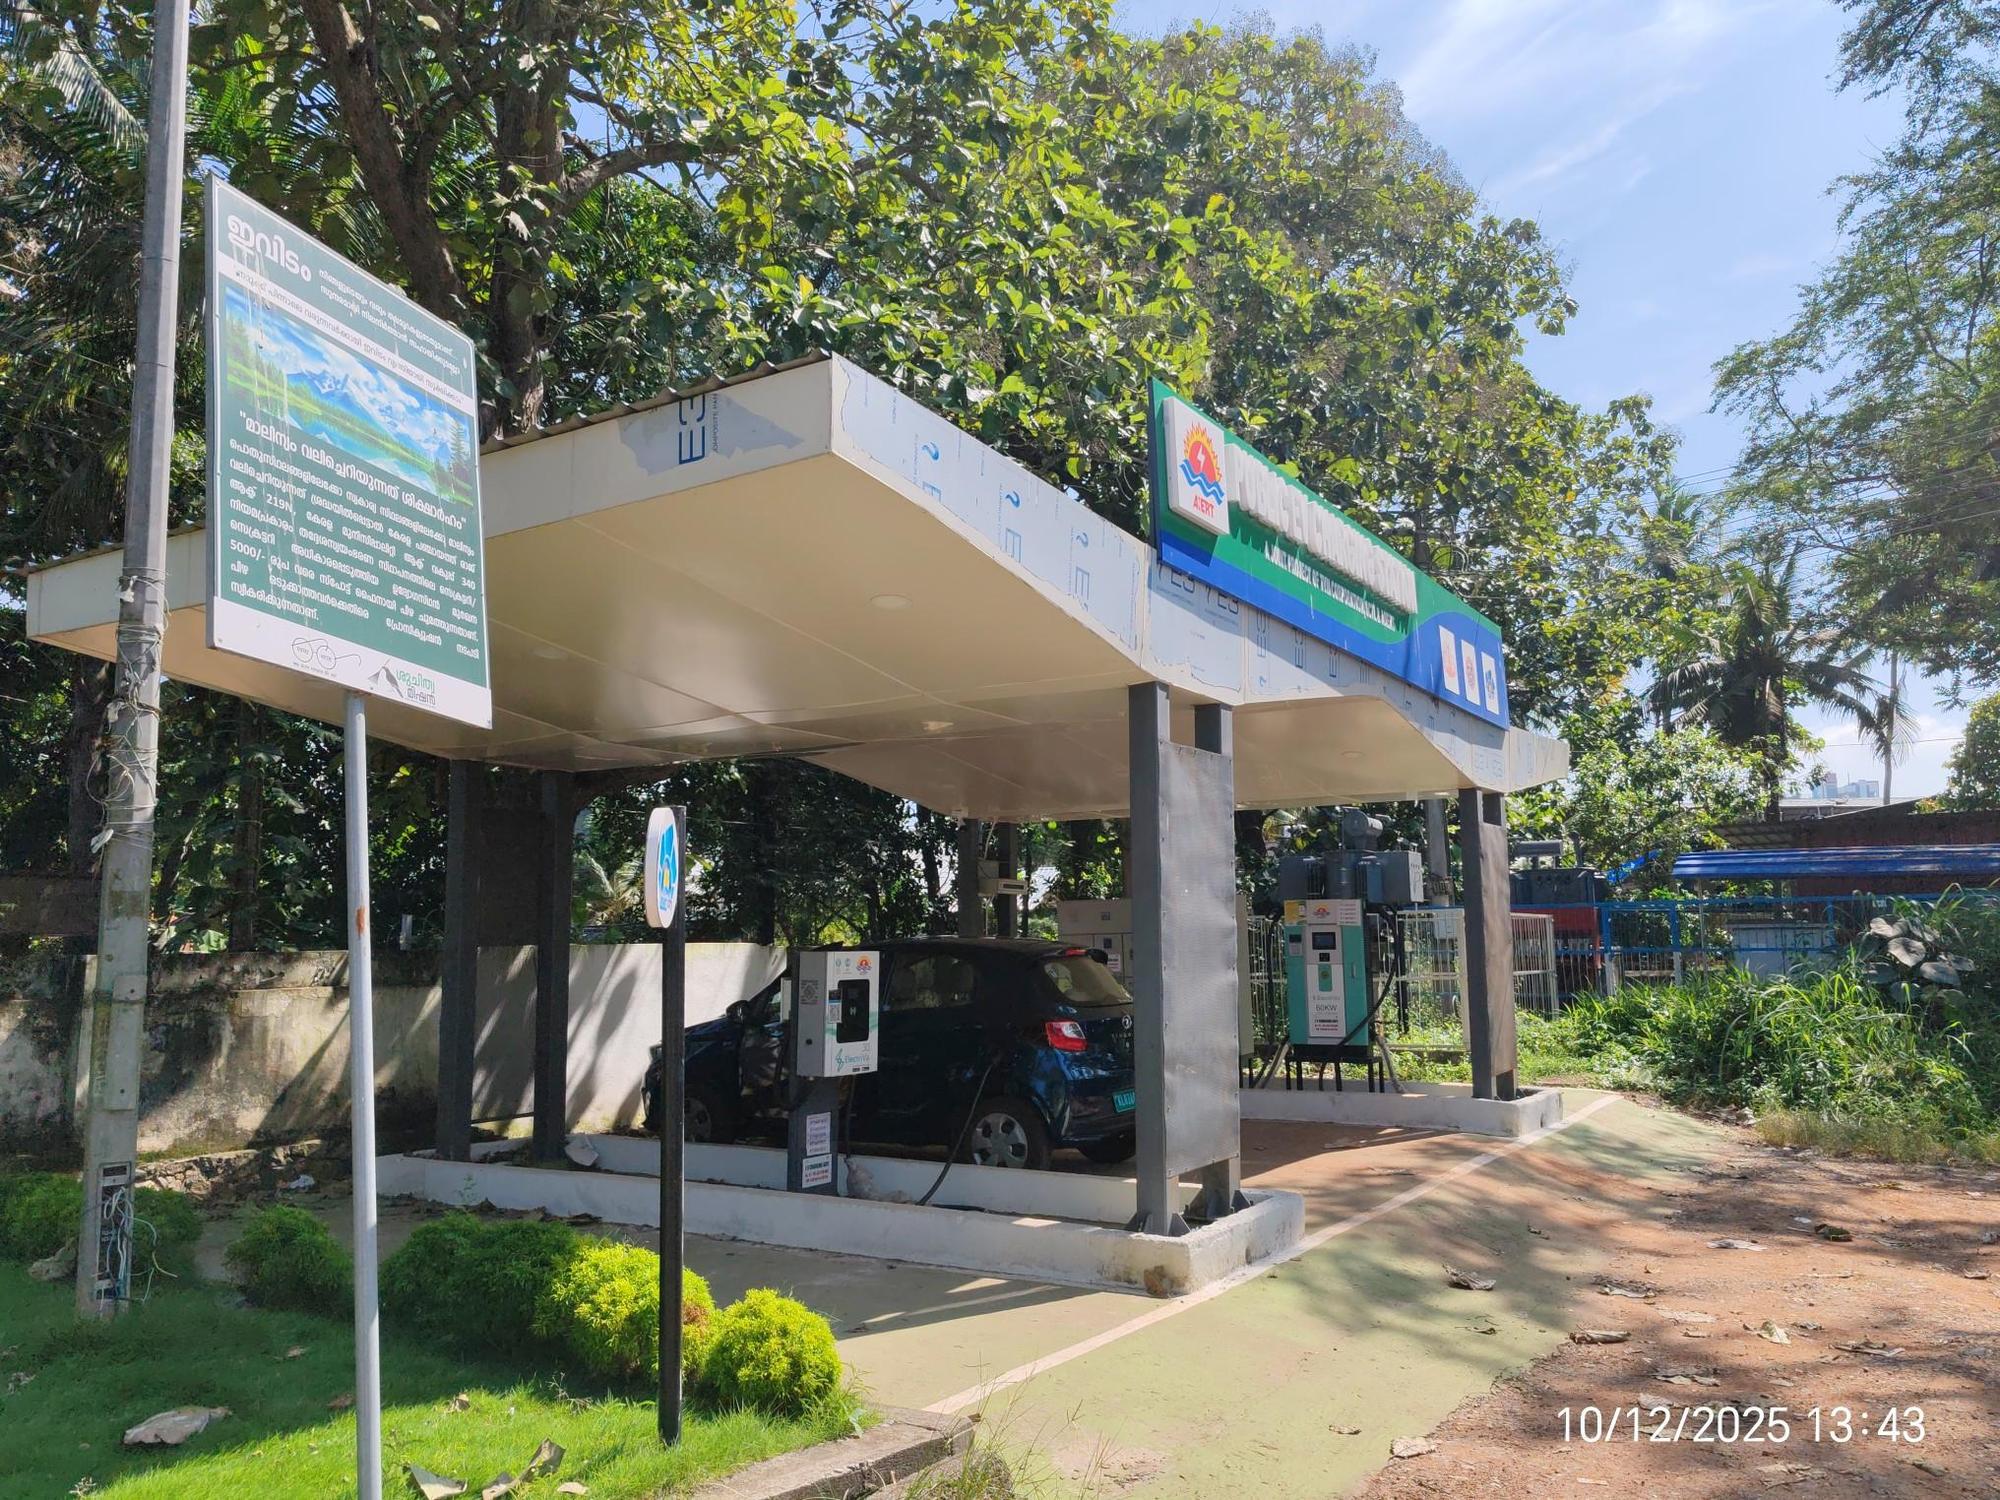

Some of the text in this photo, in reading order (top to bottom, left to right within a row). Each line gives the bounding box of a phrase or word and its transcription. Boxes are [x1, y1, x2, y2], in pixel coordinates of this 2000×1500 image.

[227, 214, 311, 281] ഇവിടം
[229, 458, 306, 499] വലിച്ചെറിയുന്നത്
[387, 527, 411, 547] കേരള
[301, 443, 399, 500] വലിച്ചെറിയുന്നത്
[230, 538, 265, 560] 5000/-
[266, 493, 296, 516] 219N,
[306, 511, 333, 531] കേരള
[461, 576, 475, 590] 340
